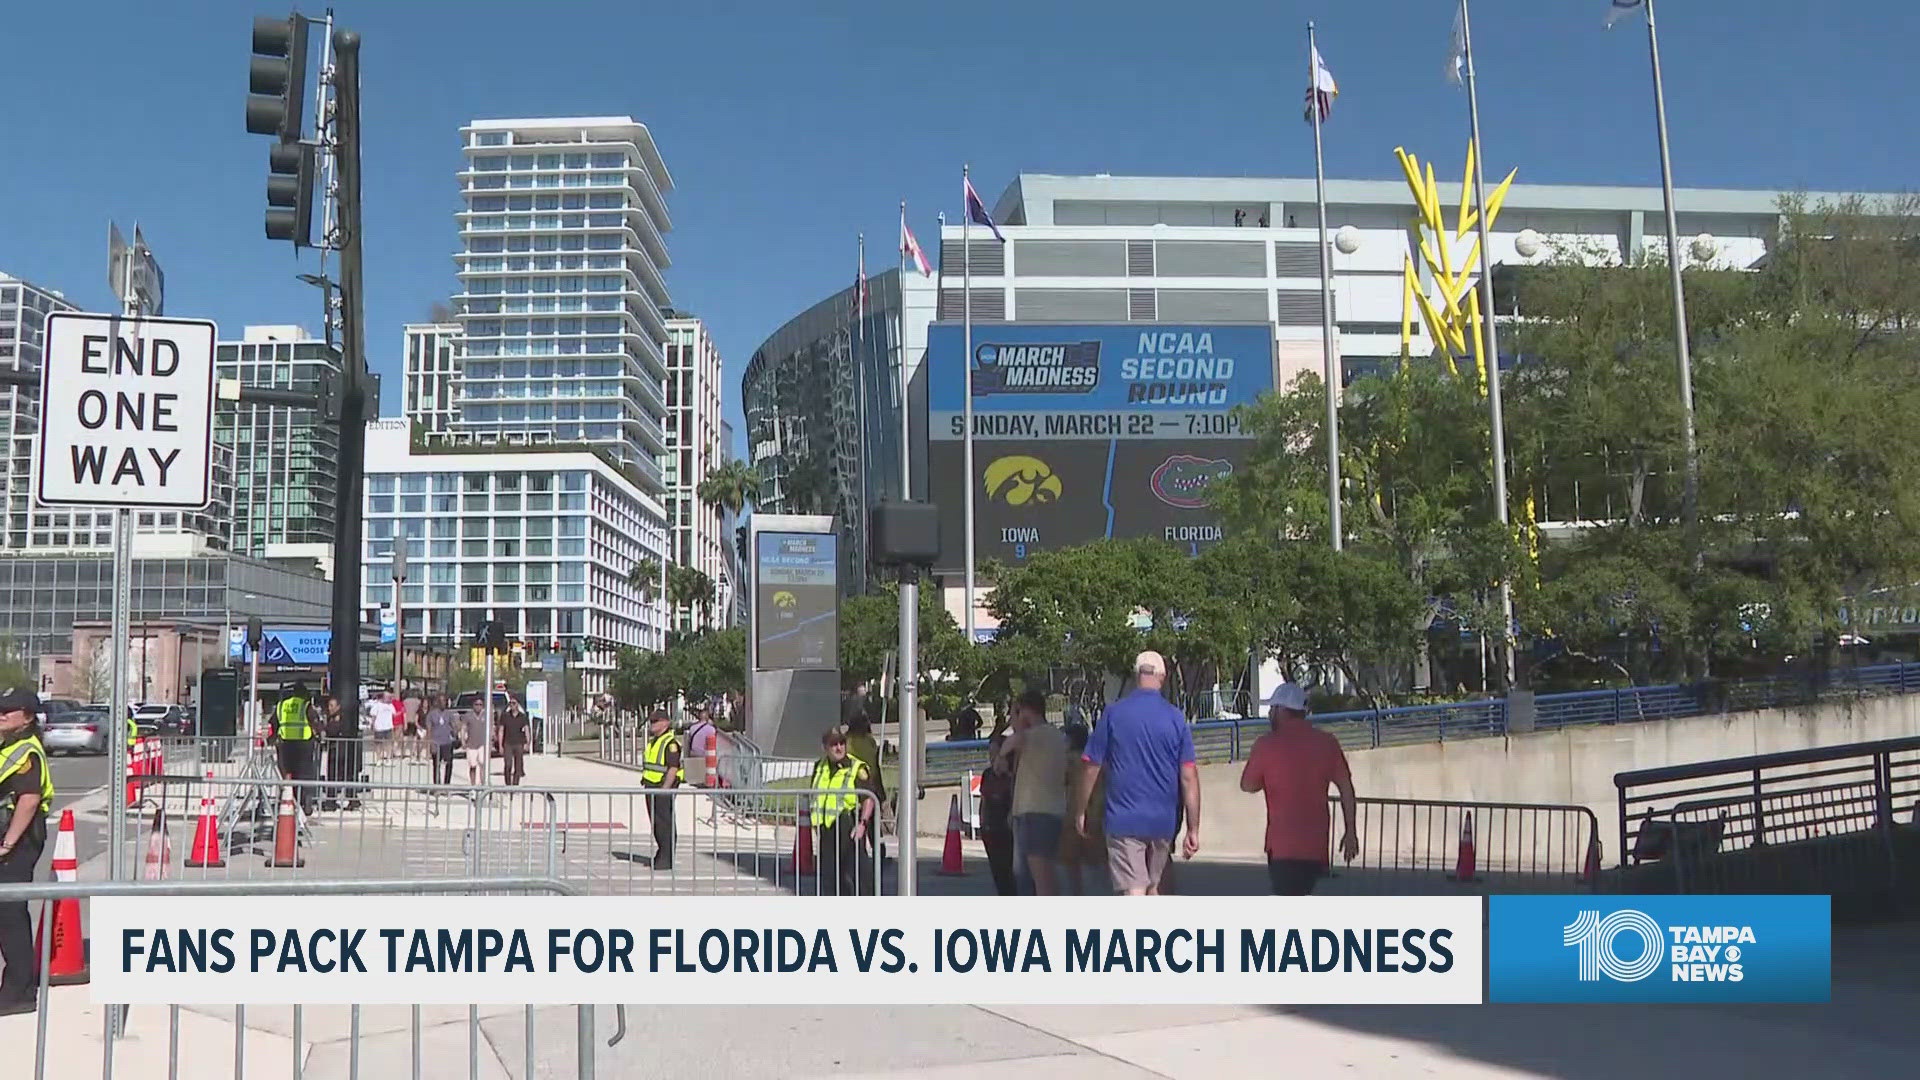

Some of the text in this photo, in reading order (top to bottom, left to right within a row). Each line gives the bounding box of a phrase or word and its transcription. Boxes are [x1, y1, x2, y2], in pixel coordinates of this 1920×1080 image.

[1138, 332, 1213, 354] NCAA
[81, 335, 180, 377] END
[997, 346, 1065, 366] MARCH
[1005, 366, 1097, 386] MADNESS
[1120, 358, 1234, 379] SECOND
[1127, 382, 1226, 404] ROUND
[77, 389, 178, 432] ONE
[368, 420, 407, 431] EDITION
[951, 414, 1039, 438] SUNDAY,
[1045, 414, 1121, 435] MARCH
[1128, 414, 1154, 435] 22
[1185, 413, 1252, 435] 7:10P
[70, 445, 181, 487] WAY
[1001, 527, 1039, 543] IOWA
[1165, 526, 1222, 541] FLORIDA
[1015, 544, 1025, 559] 9
